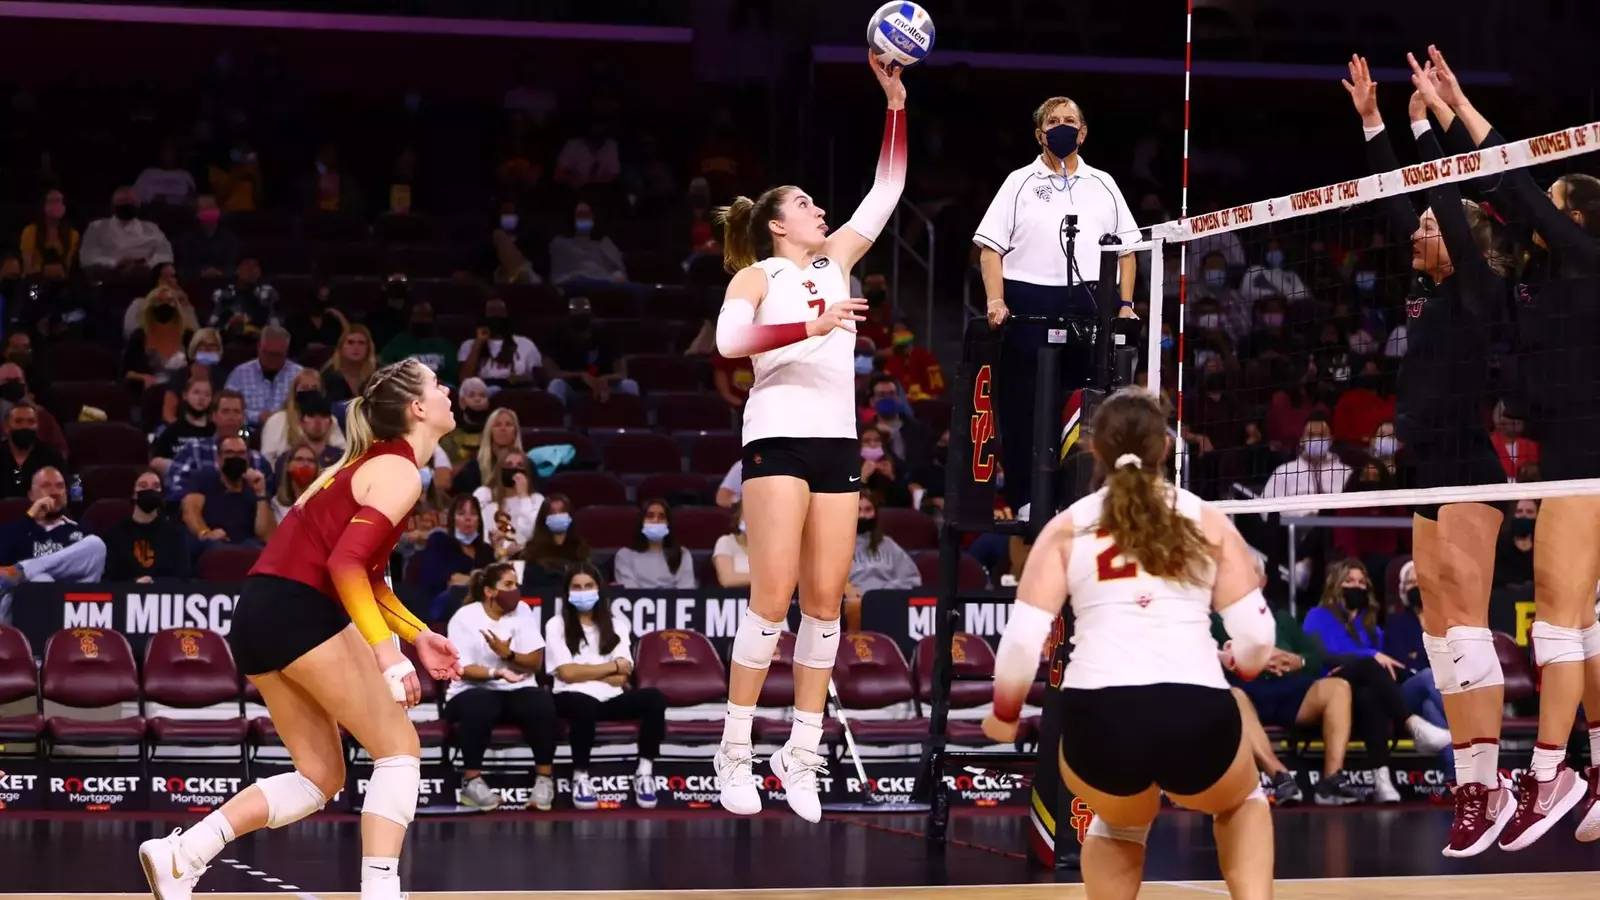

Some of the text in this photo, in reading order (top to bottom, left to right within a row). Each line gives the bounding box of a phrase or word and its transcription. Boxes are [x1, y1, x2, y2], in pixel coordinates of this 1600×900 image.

[894, 18, 926, 45] molten
[1529, 130, 1572, 157] WOMEN
[1574, 126, 1588, 147] OF
[1455, 152, 1481, 175] TROY
[1290, 190, 1322, 212] WOMEN
[1323, 187, 1335, 205] OF
[1336, 180, 1360, 199] TROY
[1189, 211, 1224, 234] WOMEN
[1234, 204, 1254, 225] TROY
[808, 298, 826, 319] 7
[64, 601, 113, 629] MM
[126, 593, 240, 637] MUSC
[0, 775, 38, 790] KET
[50, 776, 140, 793] ROCKET
[152, 777, 241, 793] ROCKET
[656, 775, 723, 791] ROCKE
[1396, 770, 1444, 785] ROCK
[357, 779, 444, 795] RET
[69, 792, 123, 804] Mortgage
[171, 793, 224, 805] Mortgage
[673, 791, 721, 804] Mortgag
[961, 790, 1011, 801] Mortgage
